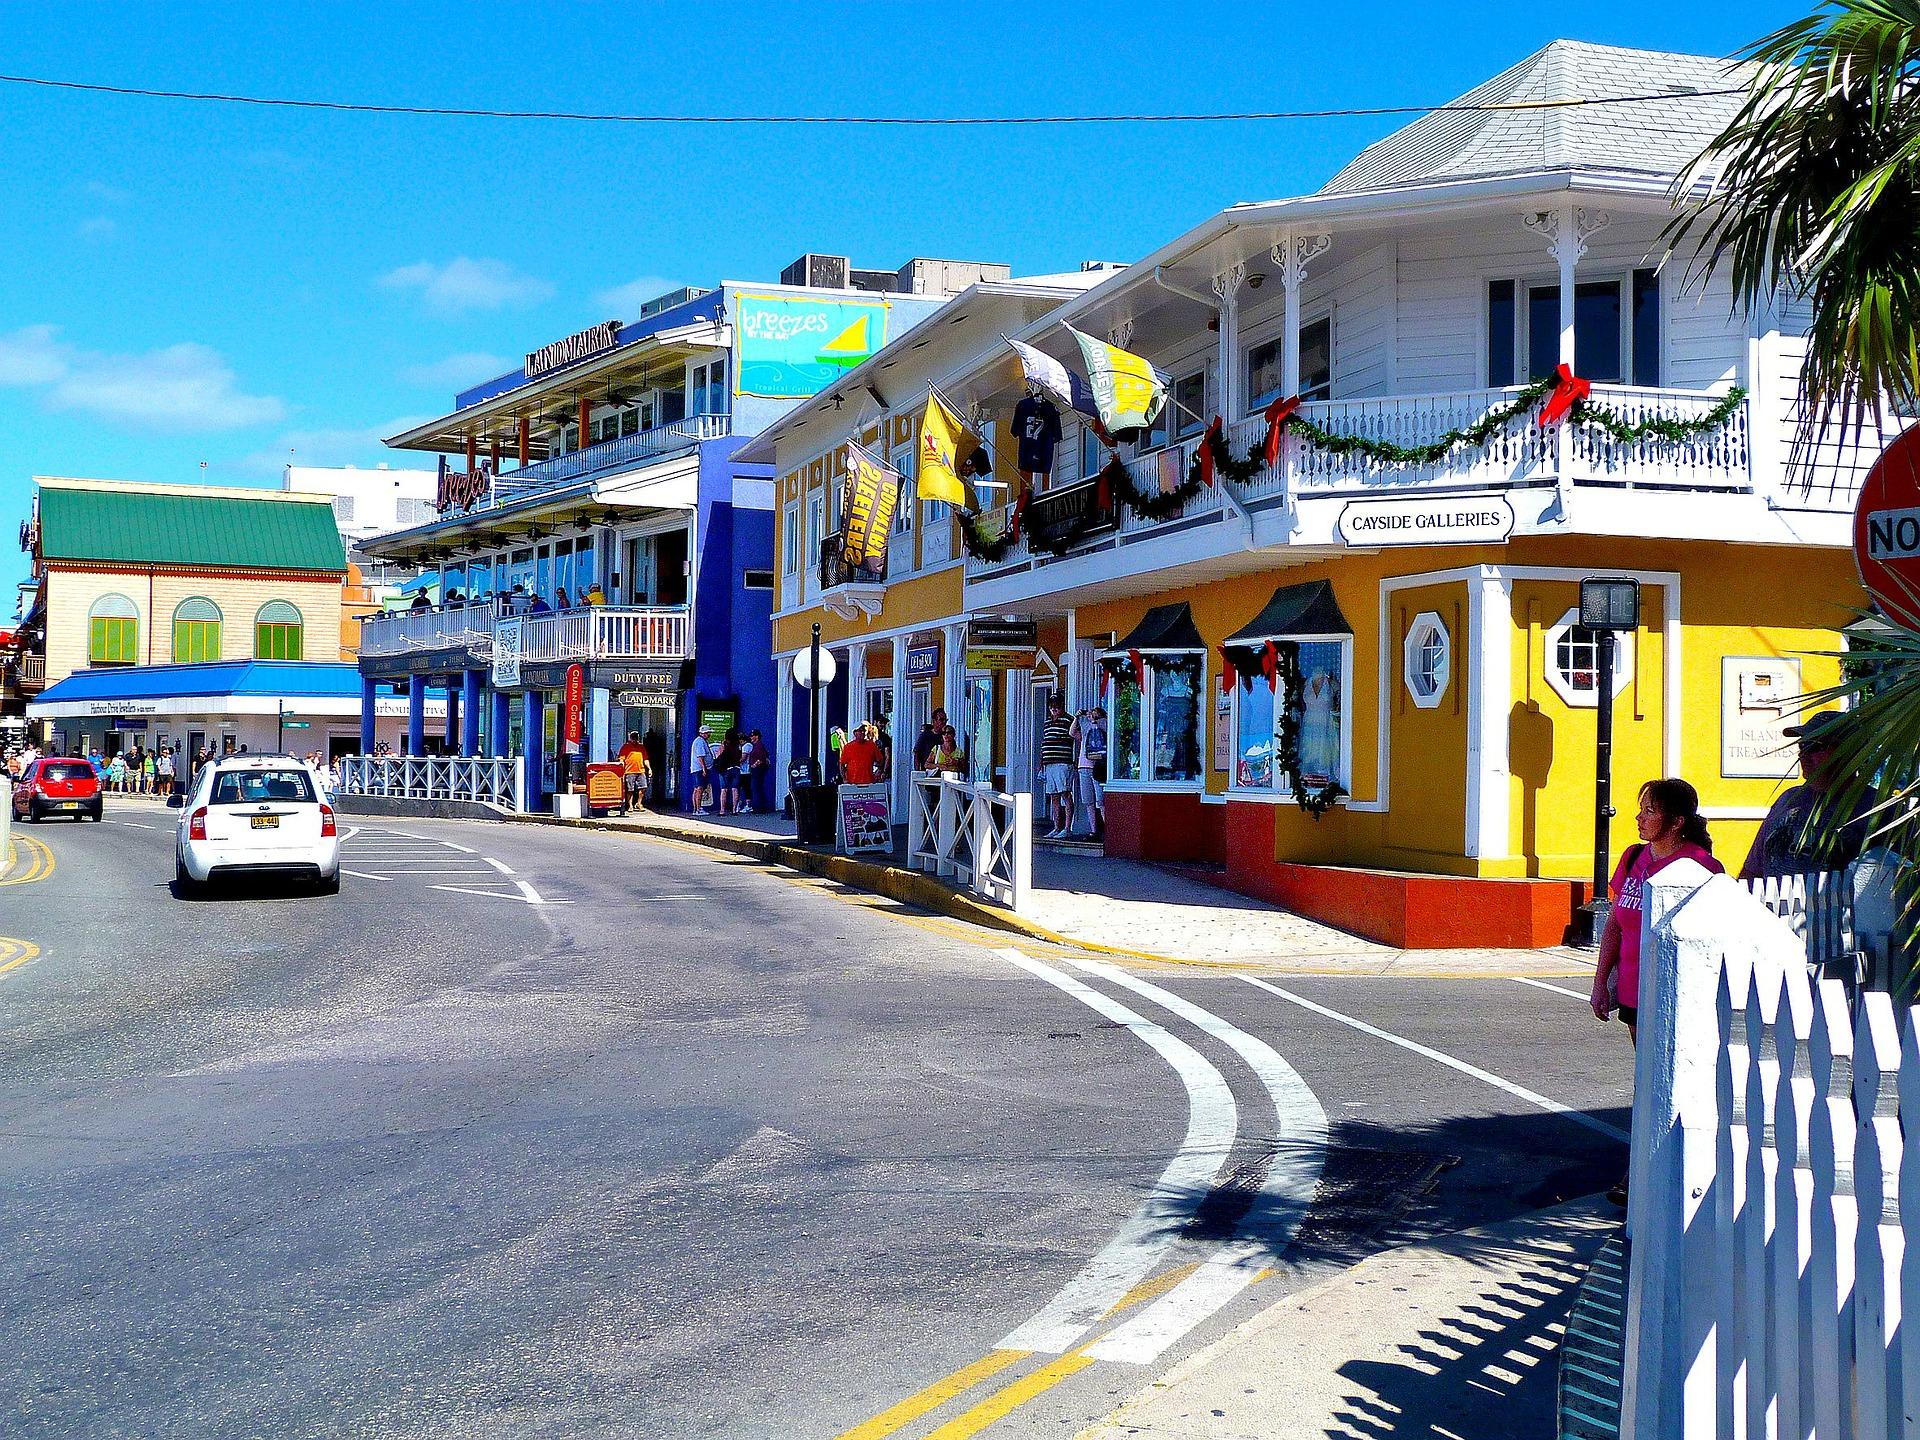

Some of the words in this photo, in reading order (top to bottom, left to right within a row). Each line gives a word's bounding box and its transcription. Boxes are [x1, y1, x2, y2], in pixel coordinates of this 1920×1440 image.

[742, 307, 829, 336] breezes
[524, 320, 614, 379] LANDMARK
[754, 384, 788, 393] Tropical
[791, 384, 811, 393] Grill
[1352, 515, 1411, 531] CAYSIDE
[1415, 511, 1500, 528] GALLERIES
[1869, 516, 1920, 554] NO
[571, 669, 580, 701] CUBAN
[614, 673, 643, 684] DUTY
[645, 673, 673, 684] FREE
[625, 694, 676, 705] LANDMARK
[425, 706, 446, 715] rive
[569, 704, 579, 738] CIGARS
[1741, 728, 1783, 741] ISLAND
